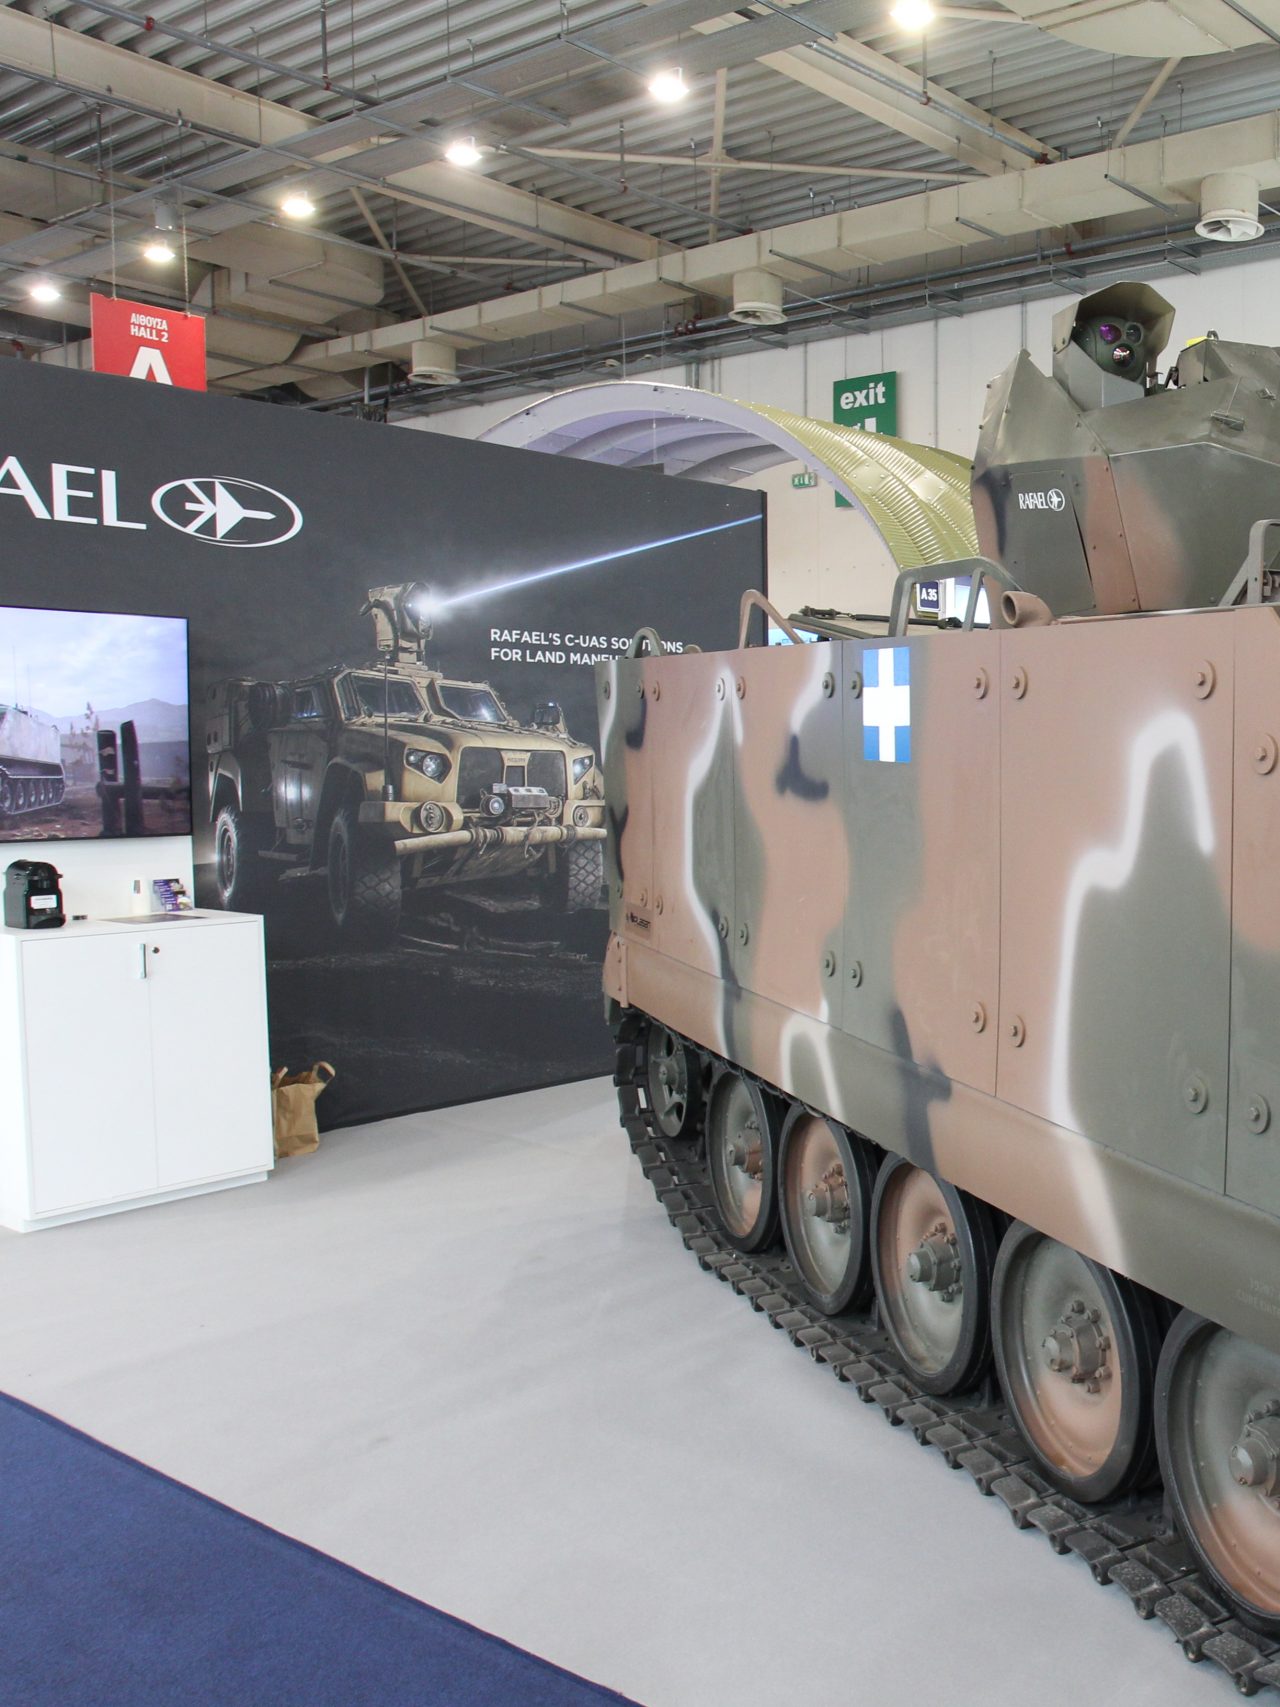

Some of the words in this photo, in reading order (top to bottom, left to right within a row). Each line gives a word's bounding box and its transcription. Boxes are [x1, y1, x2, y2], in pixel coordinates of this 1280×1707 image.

[130, 325, 159, 341] HALL
[161, 332, 169, 343] 2
[840, 381, 886, 410] exit
[1018, 492, 1049, 509] RAFAEL
[490, 629, 561, 646] RAFAEL'S
[565, 634, 608, 649] C-UAS
[490, 648, 522, 661] FOR
[526, 650, 566, 664] LAND
